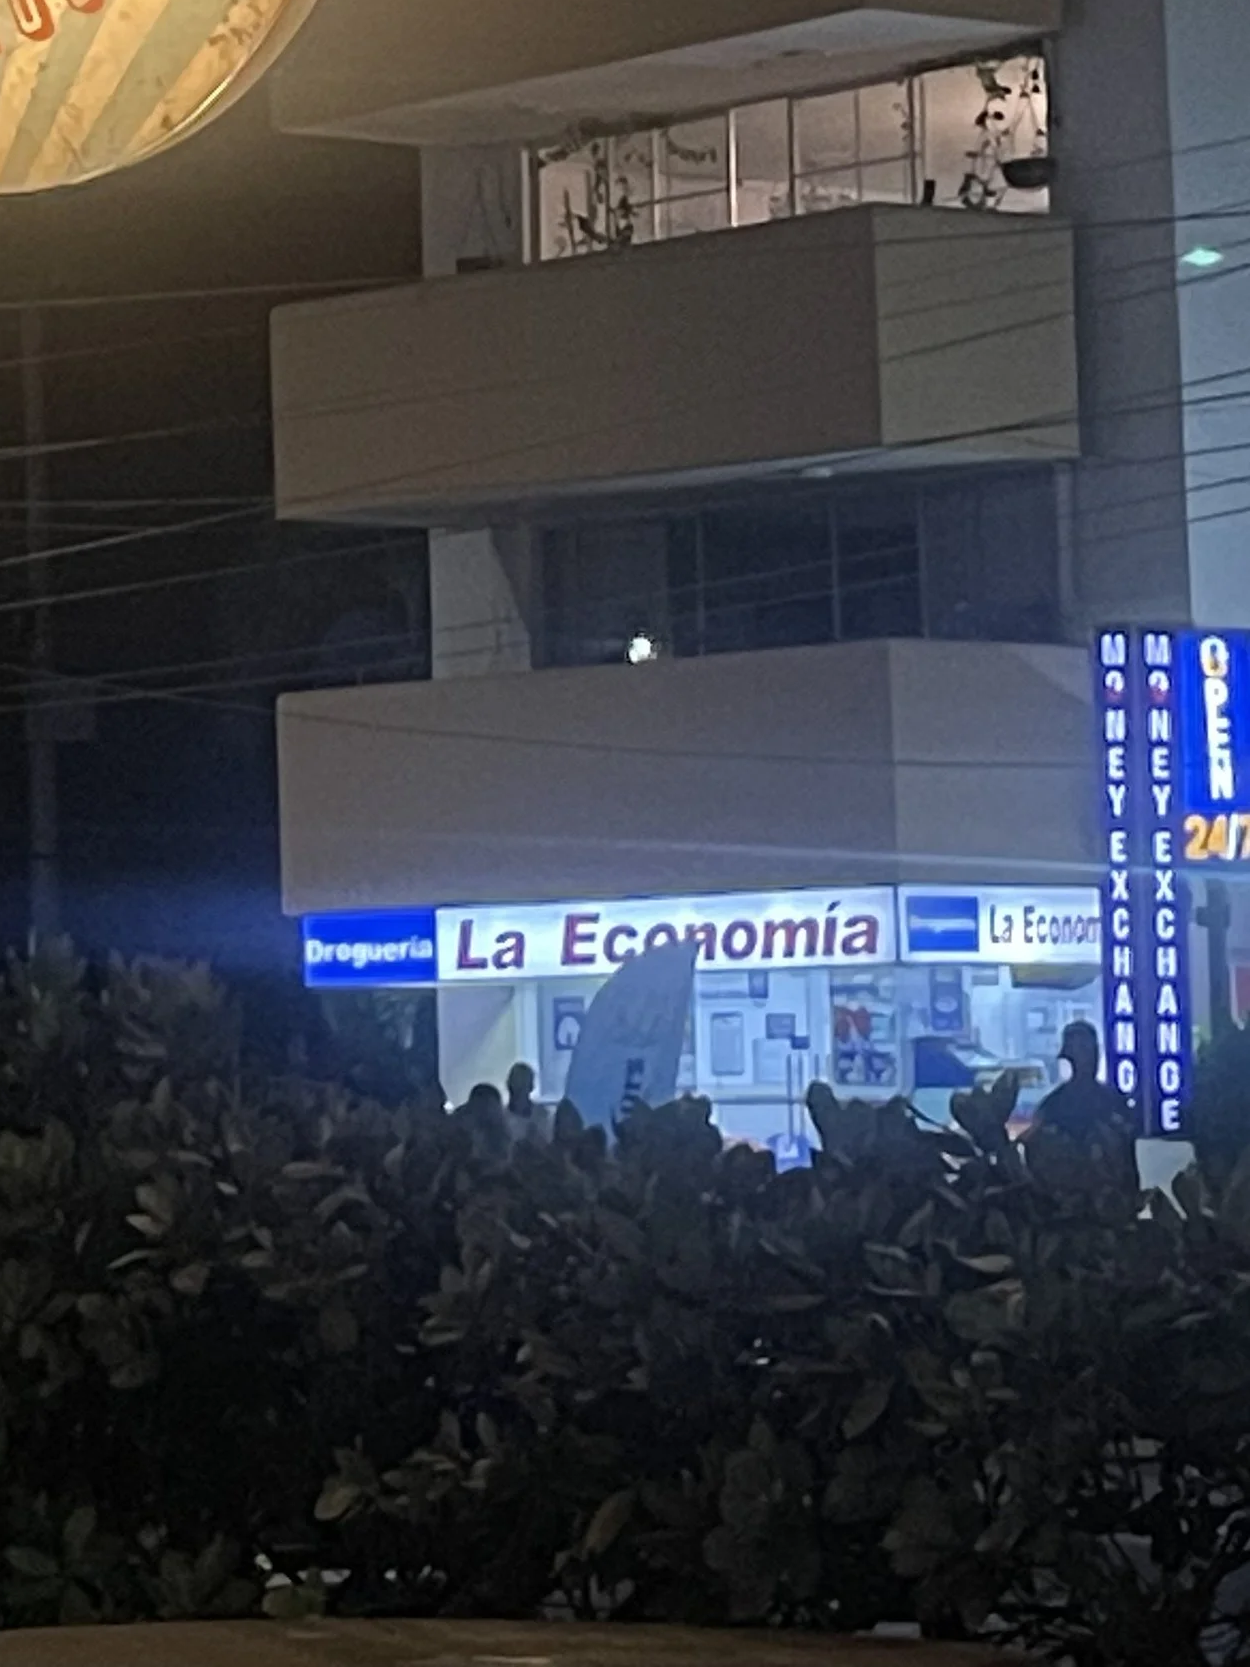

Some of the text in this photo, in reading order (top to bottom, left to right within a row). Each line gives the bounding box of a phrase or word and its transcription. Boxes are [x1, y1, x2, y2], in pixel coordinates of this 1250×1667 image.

[1199, 636, 1235, 800] OPEN
[1100, 633, 1137, 1108] MONEY EXCHANG
[1144, 633, 1181, 1131] MONEY EXCHANGE
[1183, 812, 1250, 861] 24/7
[456, 918, 527, 971] La
[989, 903, 1014, 944] La
